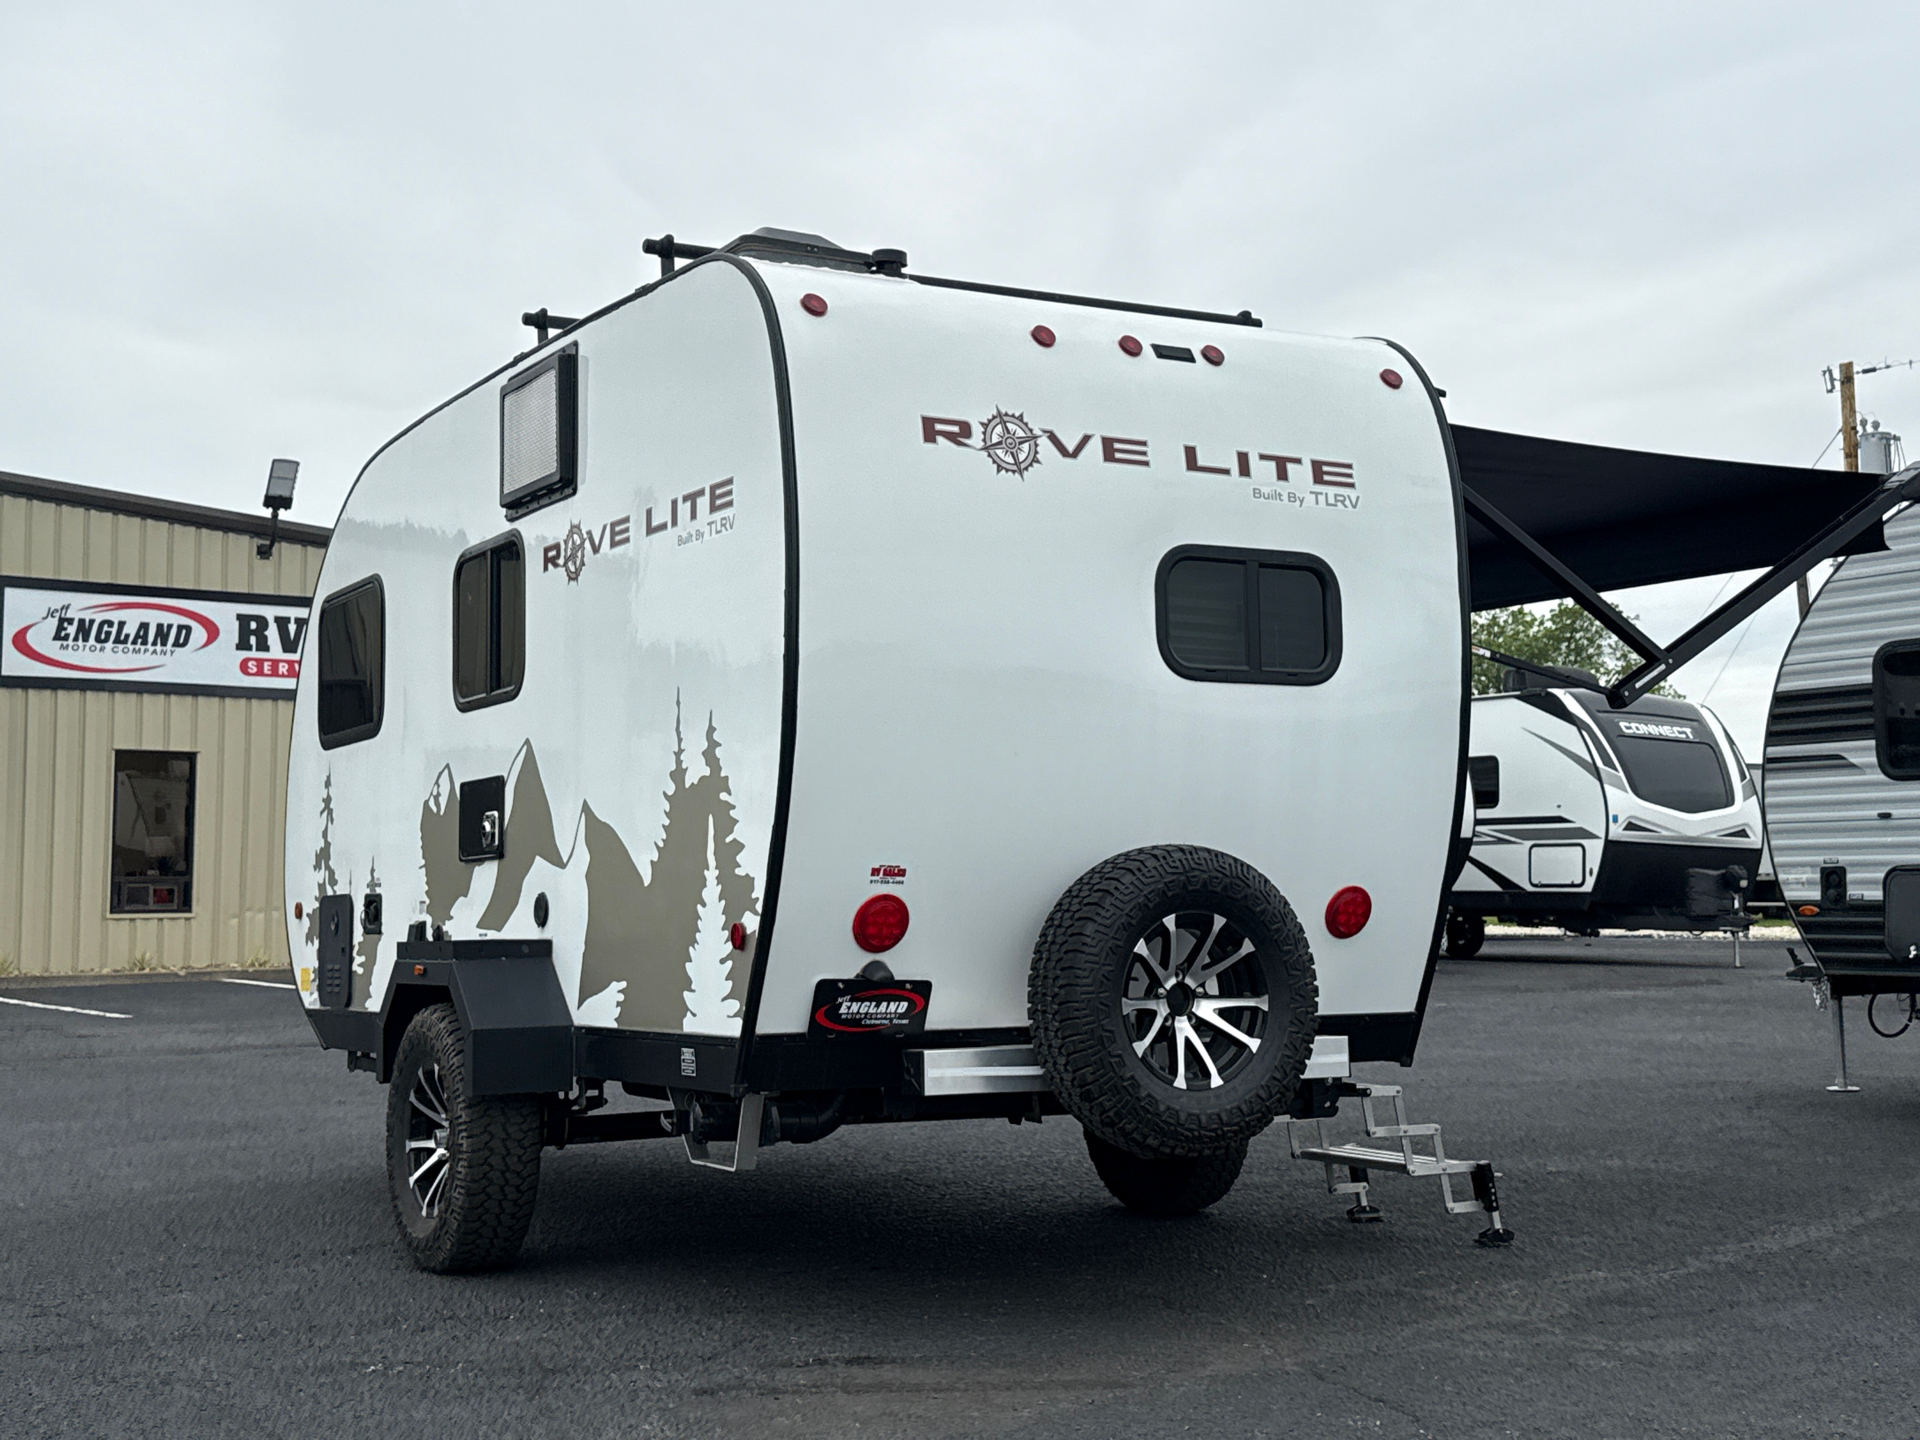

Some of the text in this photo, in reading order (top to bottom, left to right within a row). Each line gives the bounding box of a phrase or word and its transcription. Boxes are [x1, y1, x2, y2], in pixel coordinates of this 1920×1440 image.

[920, 403, 1357, 490] ROVE LITE
[1252, 487, 1360, 509] Built By TLRV
[543, 476, 735, 586] ROVE LITE
[677, 513, 737, 547] Built By TLRV
[41, 603, 71, 621] Jeff
[52, 616, 193, 649] ENGLAND
[235, 613, 308, 654] RV
[59, 643, 177, 657] MOTOR COMPANY
[1618, 721, 1694, 739] CONNECT
[838, 1001, 909, 1014] ENGLAND
